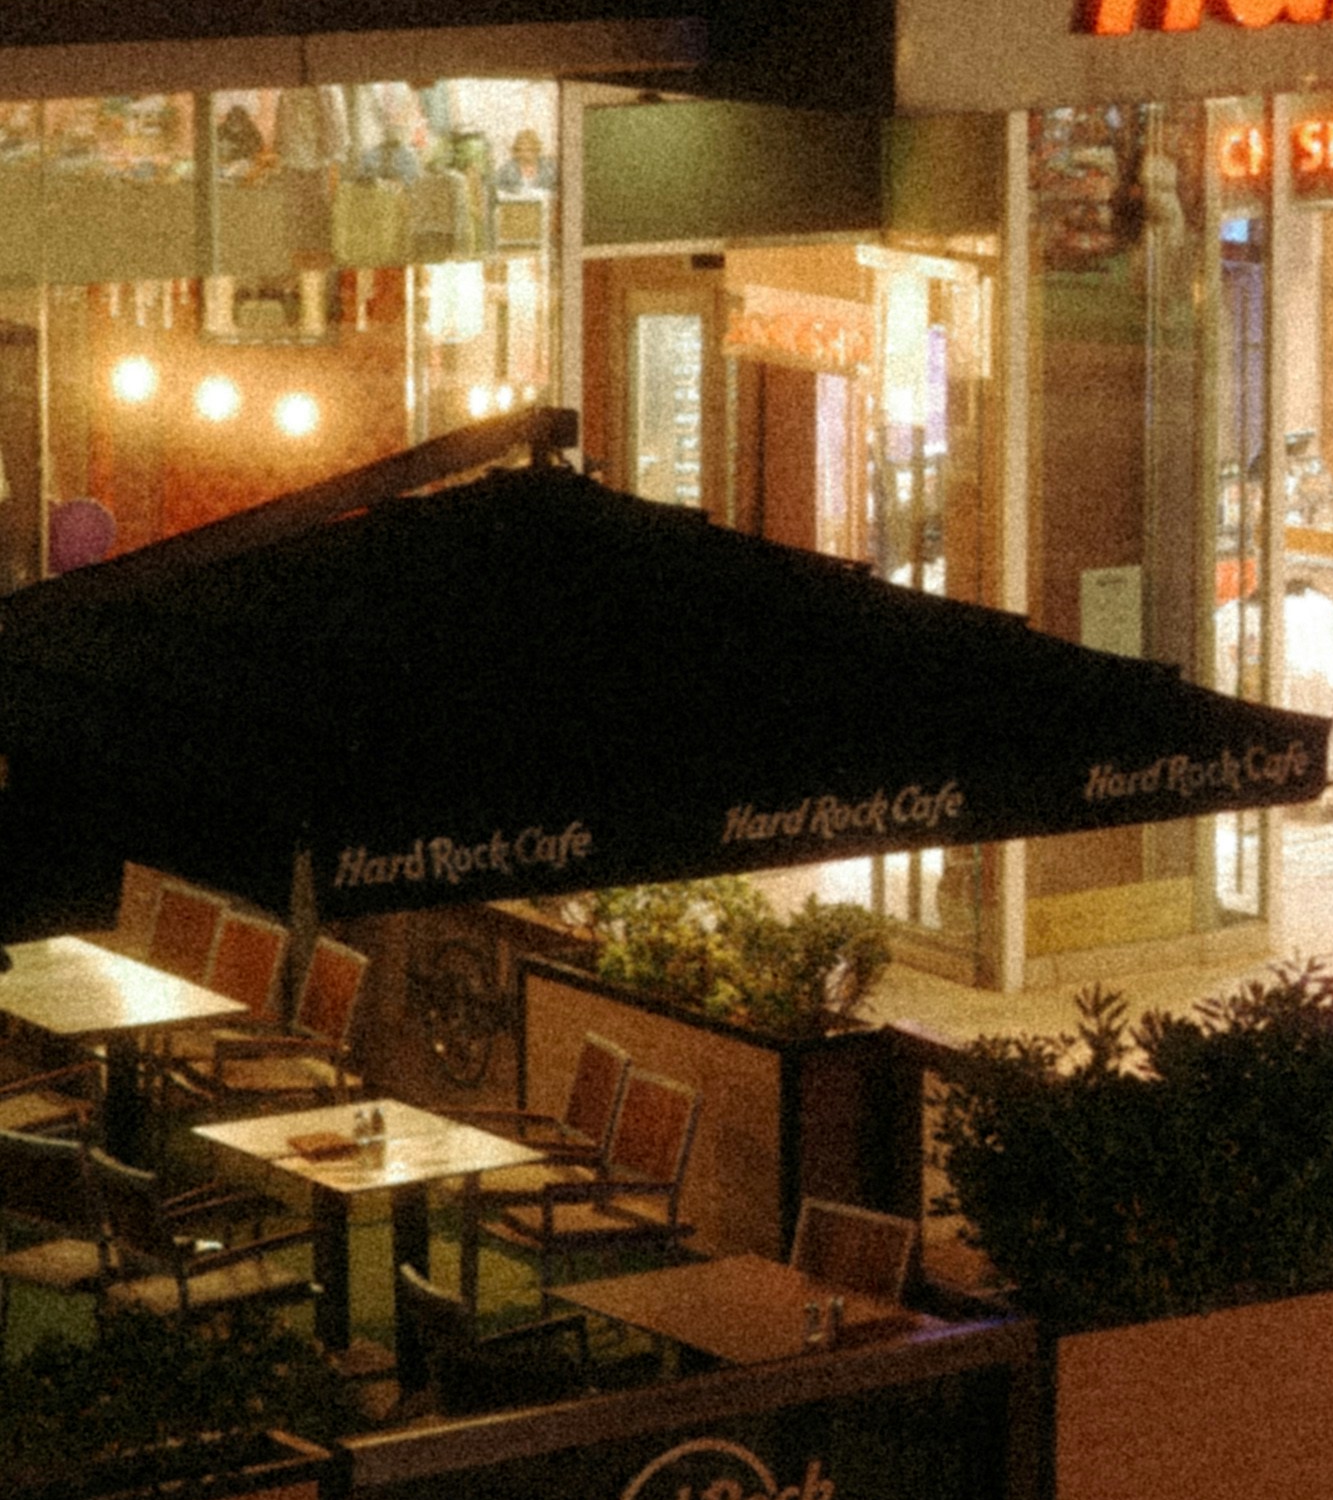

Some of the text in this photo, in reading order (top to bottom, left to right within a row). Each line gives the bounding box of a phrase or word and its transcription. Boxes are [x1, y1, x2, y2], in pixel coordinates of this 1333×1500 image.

[1083, 757, 1167, 801] Hard
[1167, 747, 1243, 797] Rock
[719, 779, 967, 845] Hard Rock Cafe
[333, 819, 594, 889] Hard Rock Cafe
